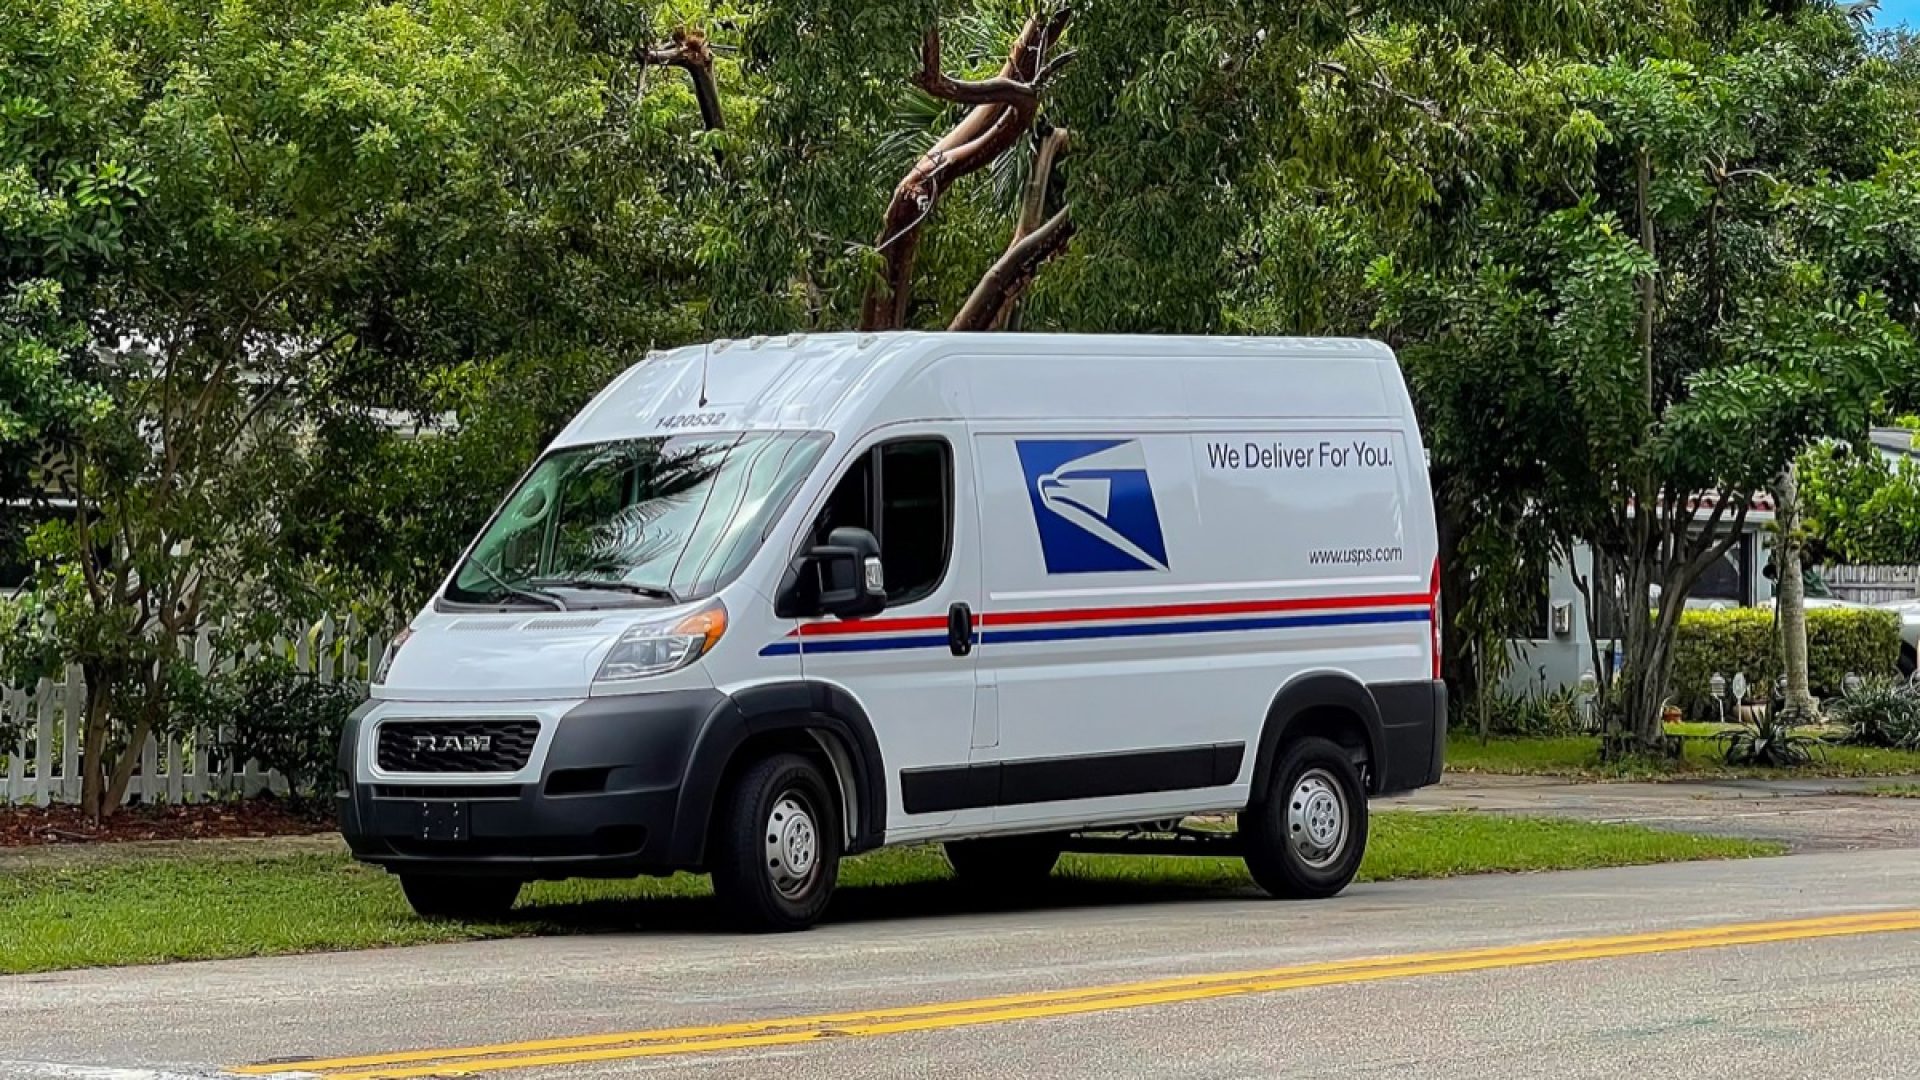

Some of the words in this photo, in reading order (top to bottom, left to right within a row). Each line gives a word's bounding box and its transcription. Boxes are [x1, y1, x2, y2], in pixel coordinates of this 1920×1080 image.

[655, 412, 727, 429] 1420532
[1207, 442, 1240, 469] We
[1245, 442, 1314, 469] Deliver
[1319, 442, 1349, 467] For
[1353, 441, 1392, 467] You.
[1309, 547, 1402, 566] www.usps.com
[409, 735, 491, 752] RAM
